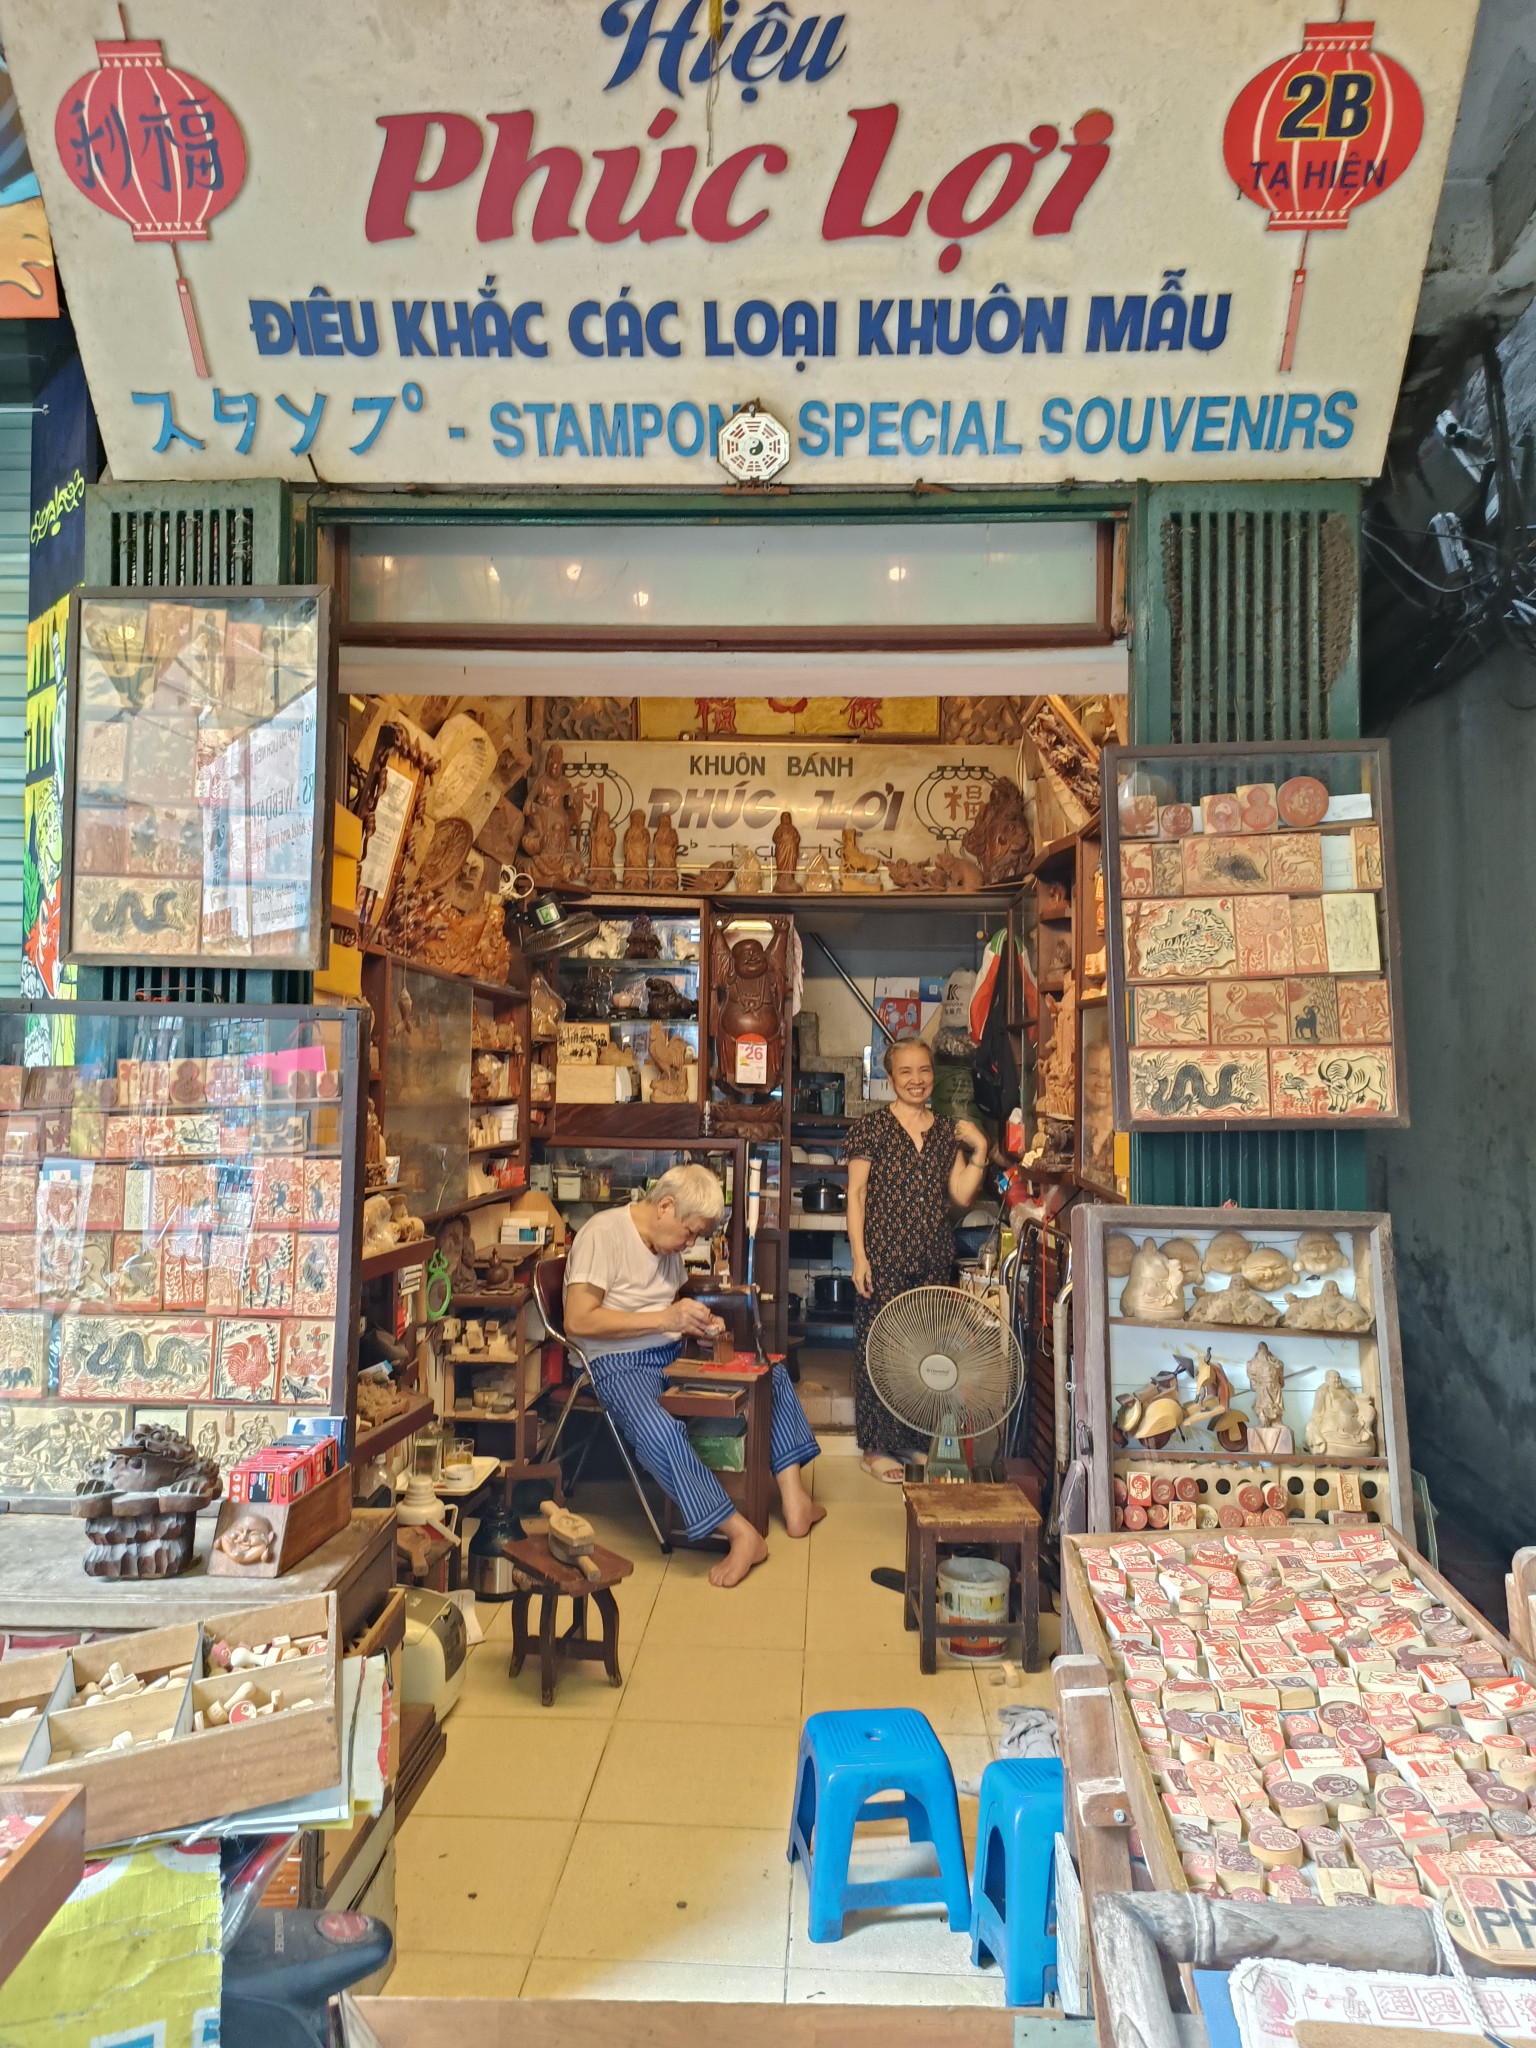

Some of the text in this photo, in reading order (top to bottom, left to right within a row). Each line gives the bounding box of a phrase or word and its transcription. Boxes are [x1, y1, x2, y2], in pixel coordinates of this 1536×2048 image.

[601, 0, 846, 103] Hiệu
[1277, 70, 1377, 141] 2B
[365, 103, 1114, 273] Phúc Lợi
[1251, 151, 1388, 196] TẠ HIỆN
[250, 268, 1232, 373] ĐIÊU KHẮC CÁC LOẠI KHUÔN MẪU
[799, 398, 1023, 458] SPECIAL
[1040, 391, 1358, 456] SOUVENIRS
[690, 751, 853, 777] KHUÔN BÁNH
[647, 781, 776, 831] PHÚC
[745, 1046, 764, 1061] 26
